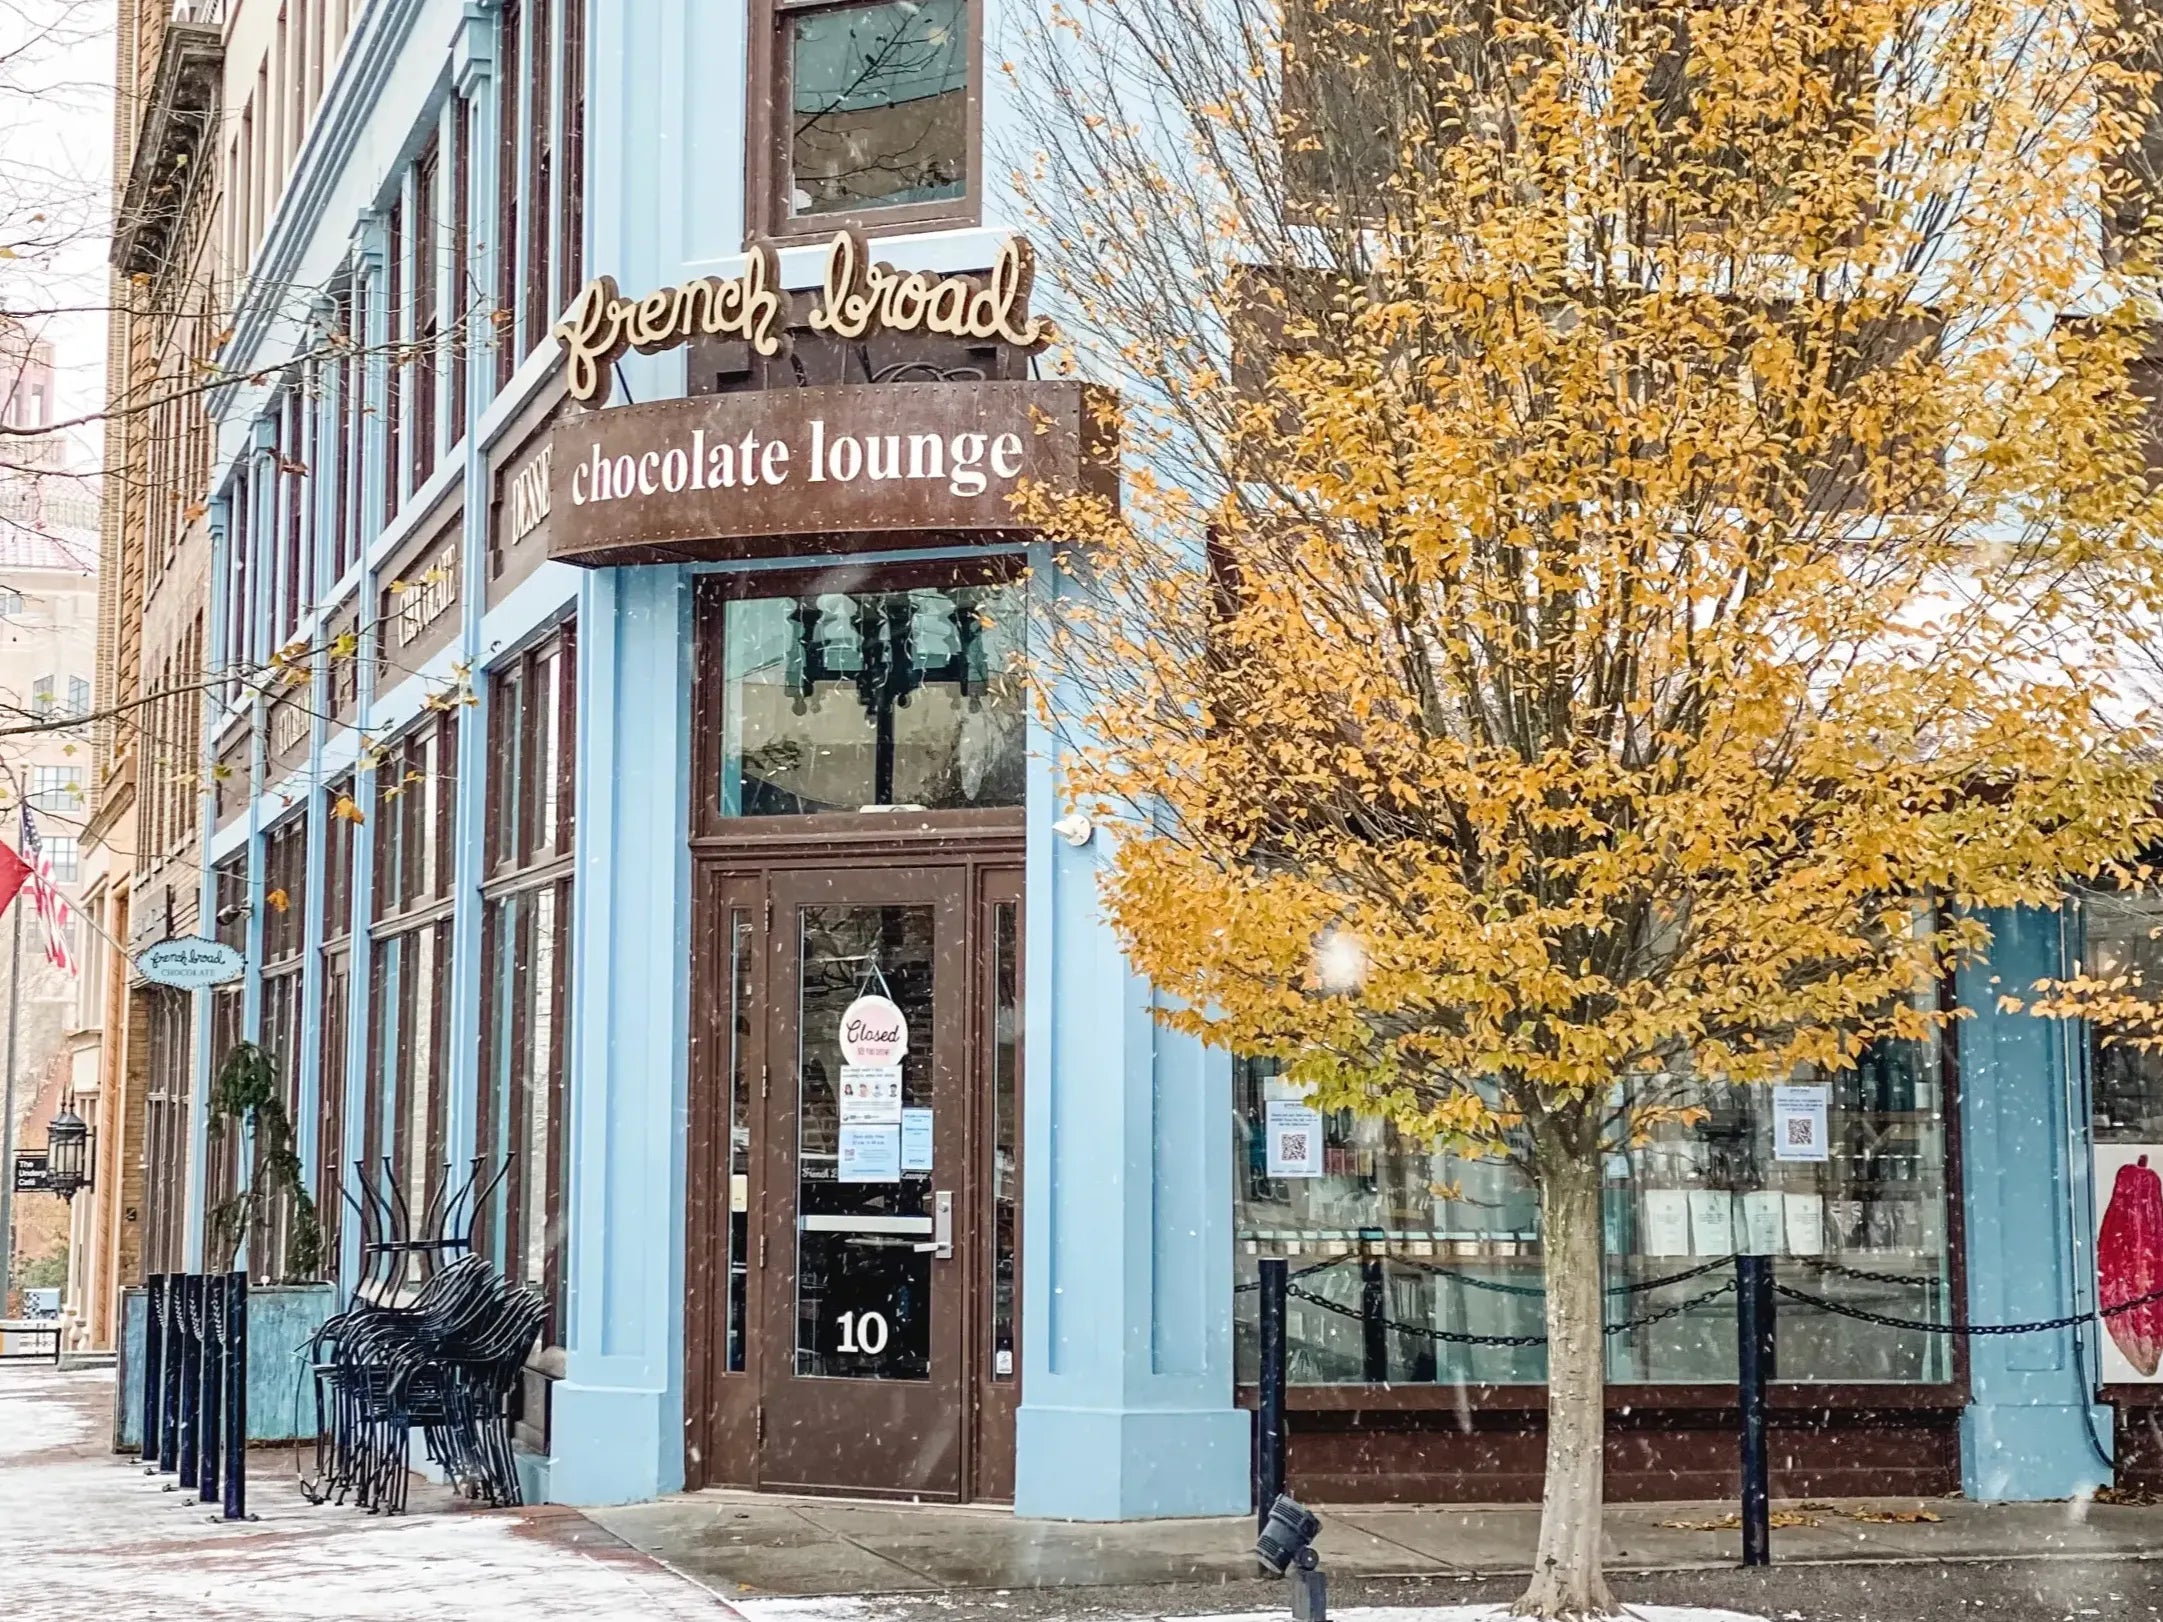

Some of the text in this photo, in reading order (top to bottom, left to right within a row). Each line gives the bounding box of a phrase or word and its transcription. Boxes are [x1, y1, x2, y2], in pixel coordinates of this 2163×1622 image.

[553, 228, 1048, 402] french broad
[571, 419, 1024, 507] chocolate lounge
[511, 442, 553, 546] DESSE
[150, 948, 226, 969] french broad
[161, 968, 216, 977] CHOCOLATE
[846, 1019, 900, 1043] Closed
[18, 1169, 48, 1179] Underg
[836, 1310, 889, 1354] 10
